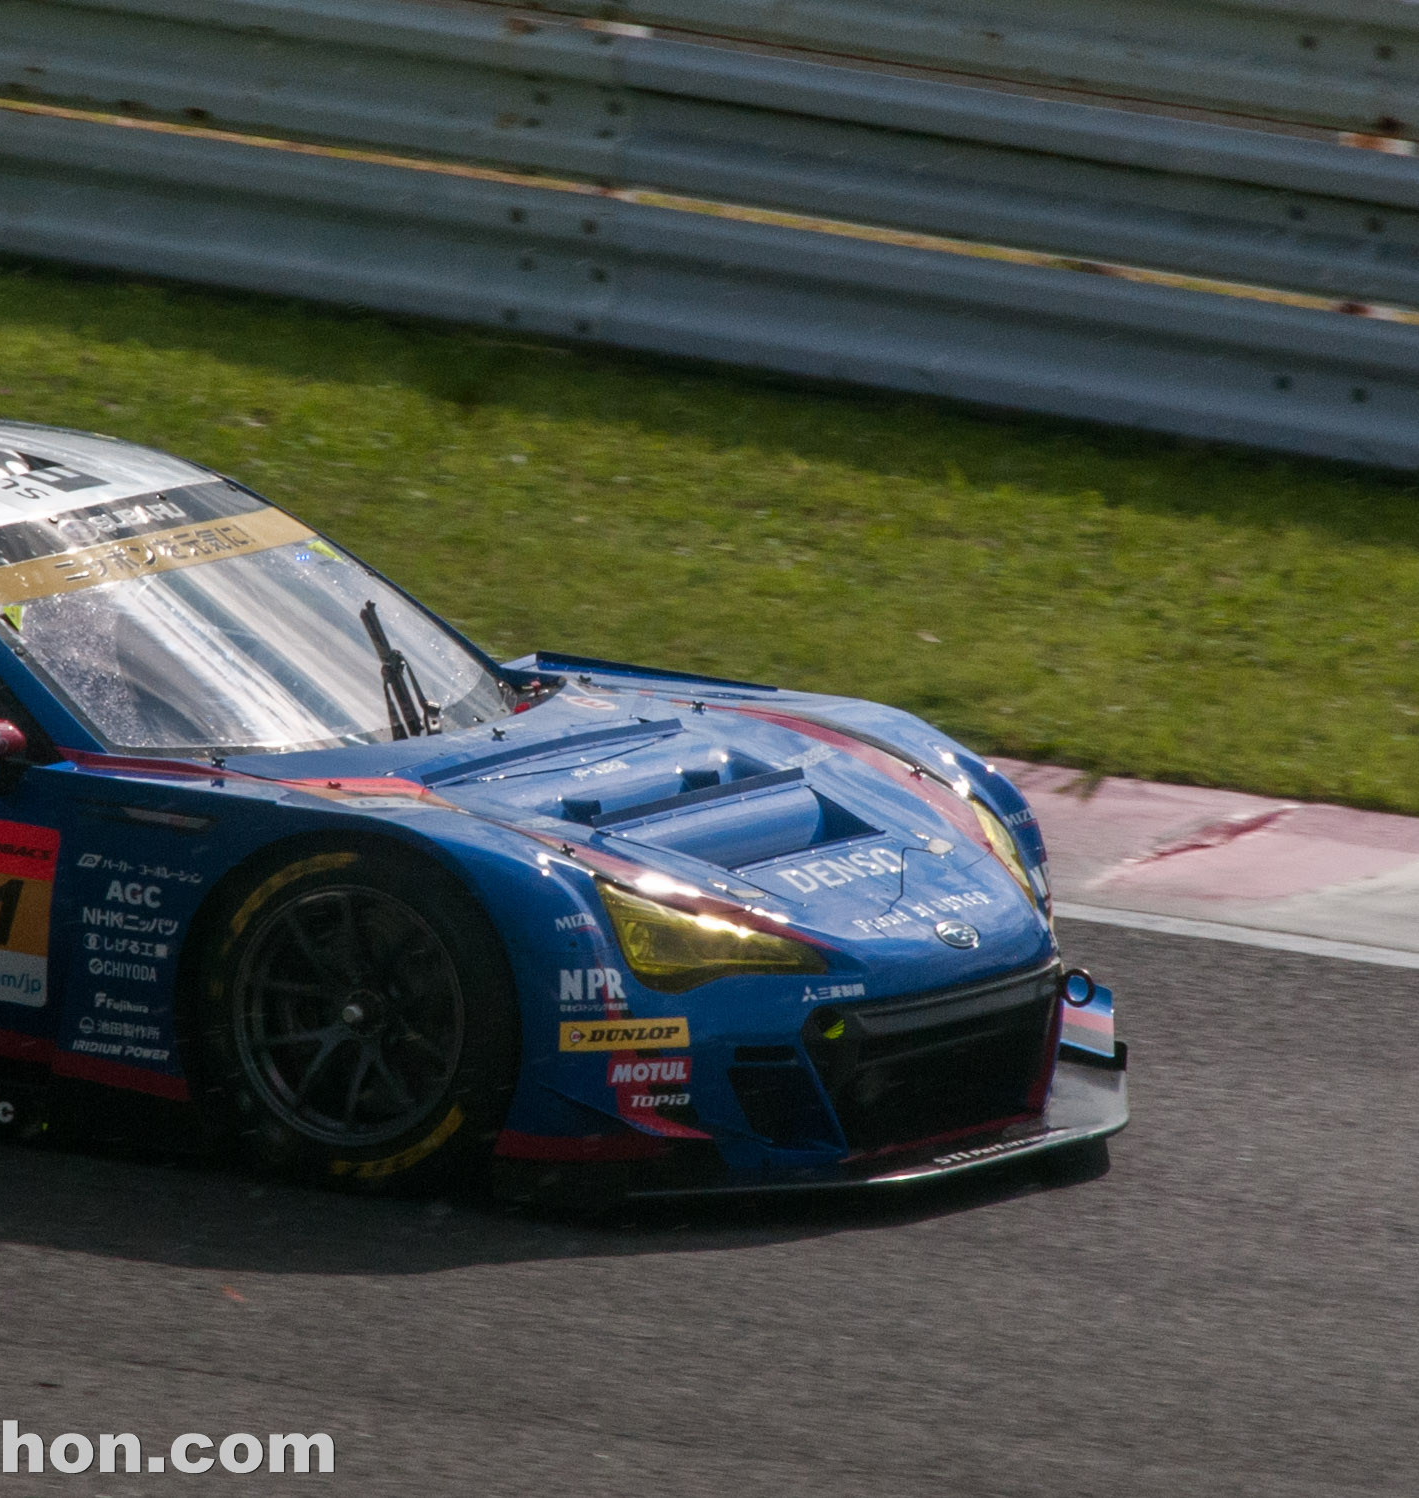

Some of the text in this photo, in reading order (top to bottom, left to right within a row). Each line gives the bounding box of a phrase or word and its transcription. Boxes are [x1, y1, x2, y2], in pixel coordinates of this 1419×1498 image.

[88, 502, 187, 533] SUBARU
[776, 848, 908, 894] DENSO
[105, 880, 162, 909] AGC
[103, 960, 157, 983] CHIYODA
[559, 967, 627, 1001] NPR
[106, 998, 149, 1014] Fujikura
[588, 1026, 680, 1043] DUNLOP
[72, 1038, 171, 1061] IRIDIUM POWER
[611, 1061, 688, 1083] MOTUL
